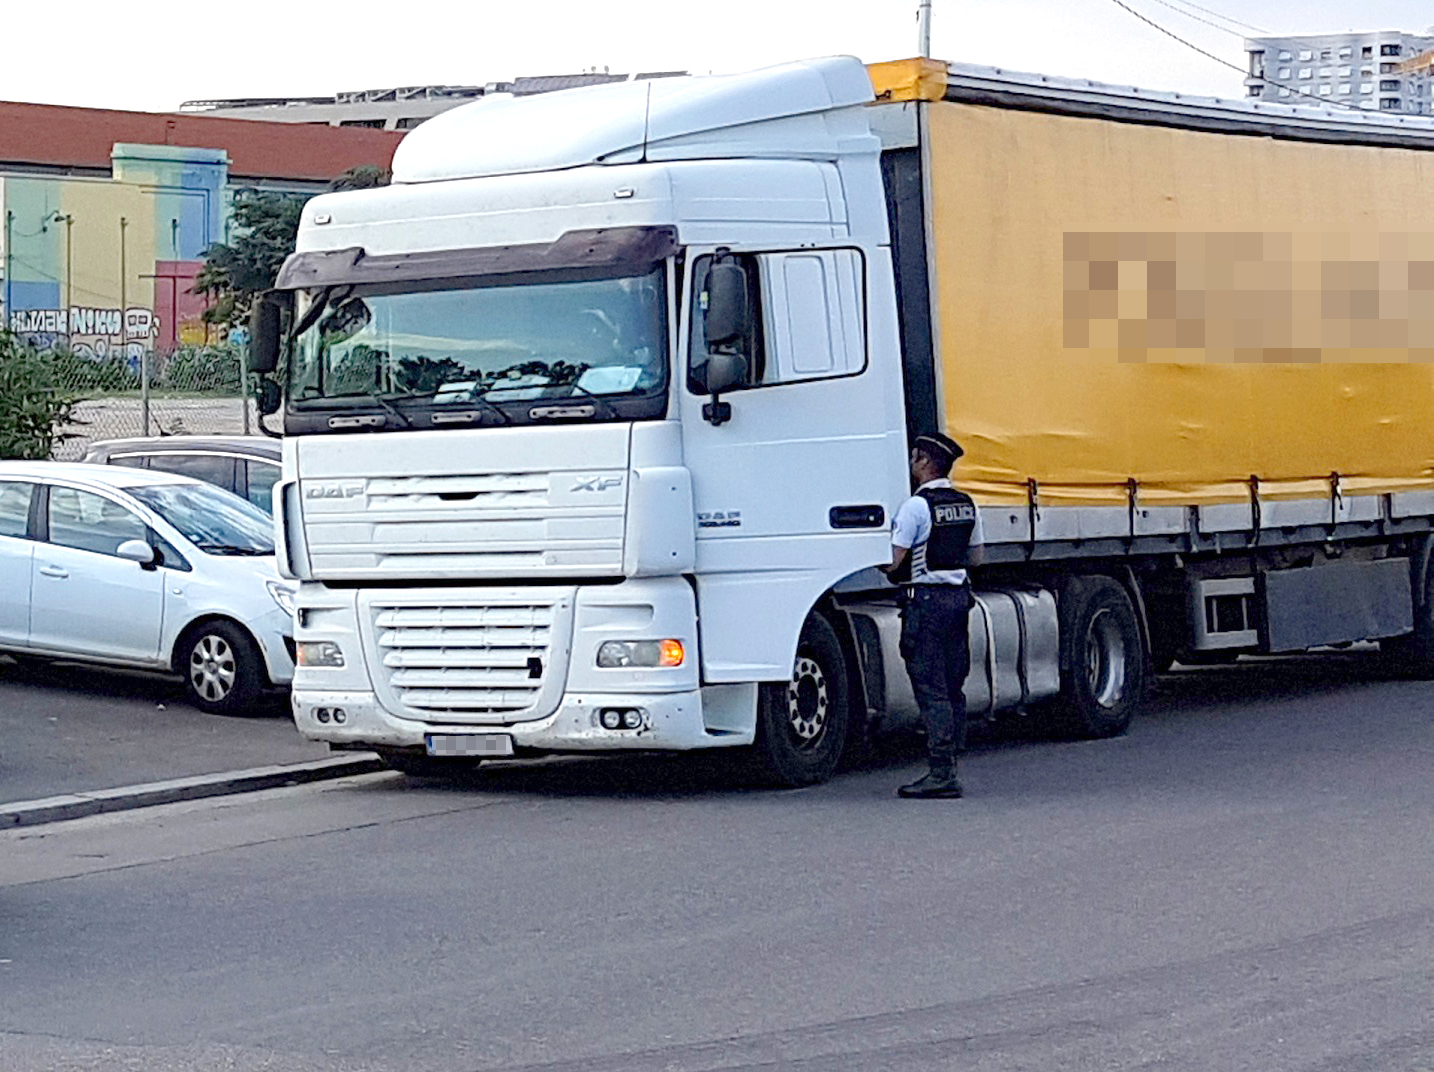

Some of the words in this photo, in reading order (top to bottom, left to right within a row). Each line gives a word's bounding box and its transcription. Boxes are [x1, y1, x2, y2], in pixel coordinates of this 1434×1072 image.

[306, 485, 364, 499] DAF
[569, 476, 623, 493] XF
[935, 506, 975, 522] POLICE
